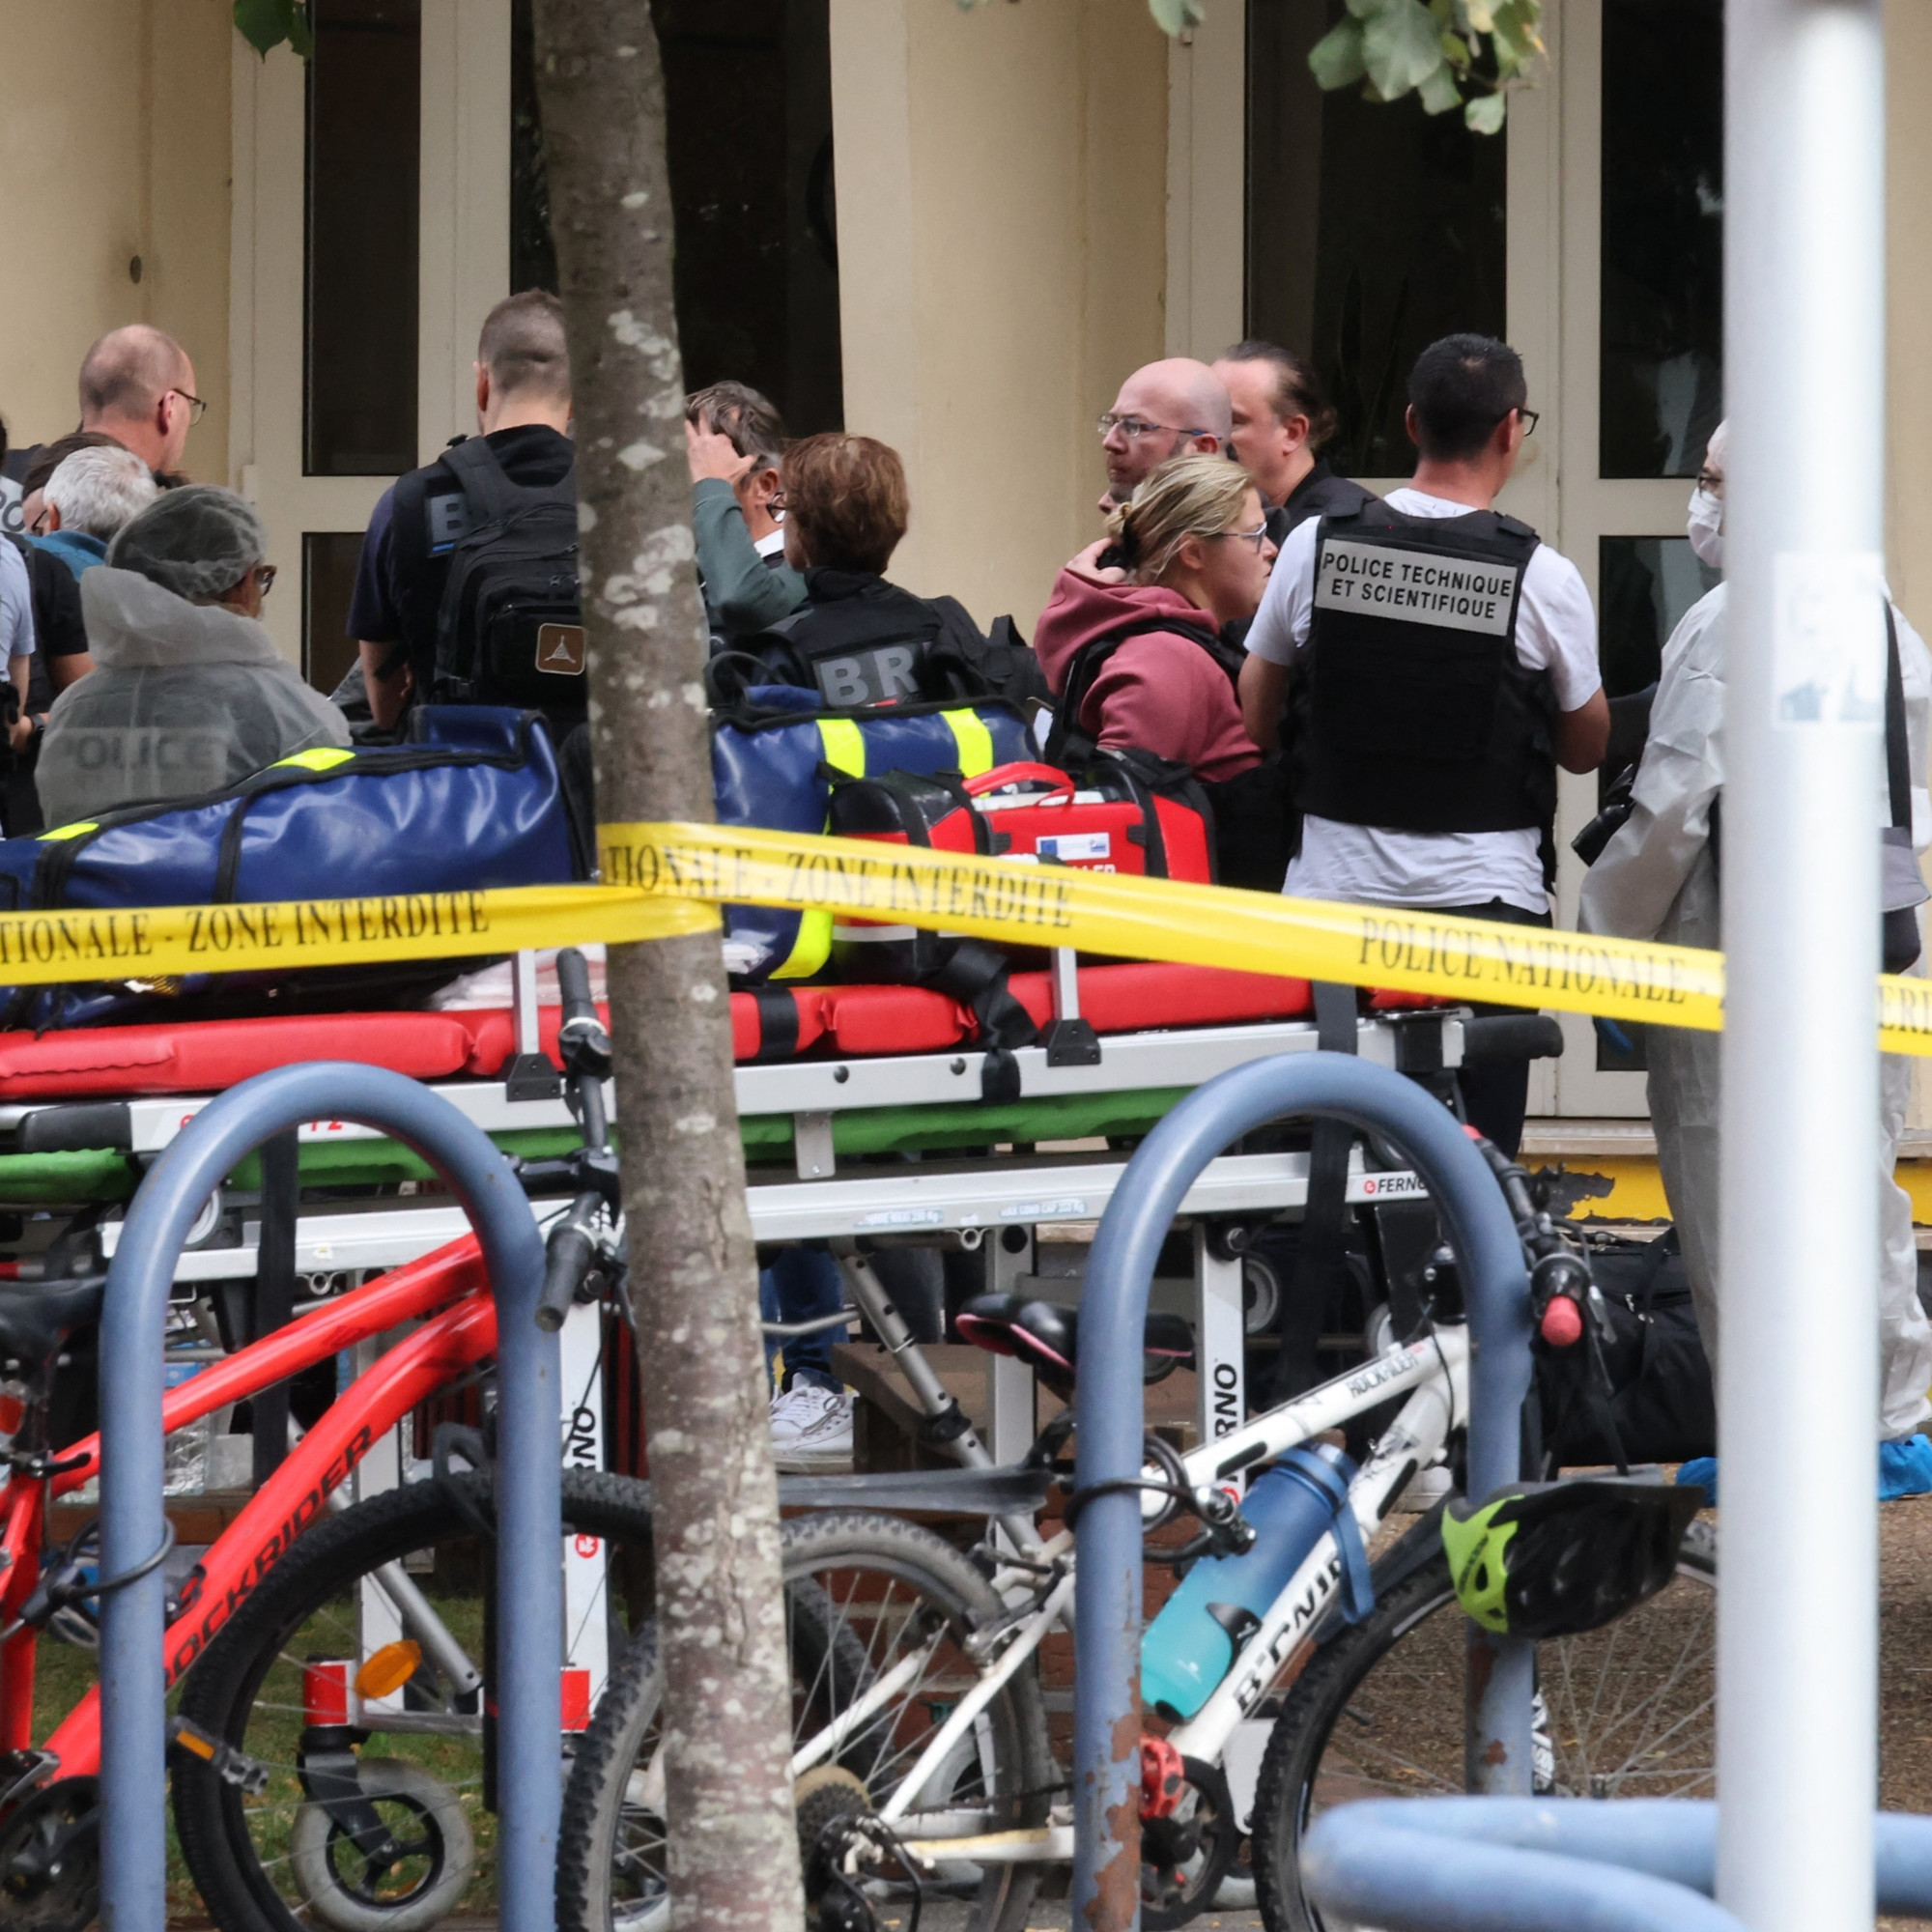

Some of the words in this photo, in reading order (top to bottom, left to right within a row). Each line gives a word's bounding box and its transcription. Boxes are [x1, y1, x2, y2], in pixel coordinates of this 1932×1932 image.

[1322, 553, 1394, 580] POLICE
[1402, 564, 1512, 597] TECHNIQUE
[1331, 579, 1354, 597] ET
[1361, 582, 1496, 618] SCIENTIFIQUE
[820, 641, 931, 706] BR
[786, 853, 875, 908] ZONE
[890, 863, 1074, 927] INTERDITE
[186, 907, 282, 952] ZONE
[296, 892, 490, 946] INTERDITE
[1359, 917, 1482, 979] POLICE
[1493, 934, 1686, 1005] NATIONALE
